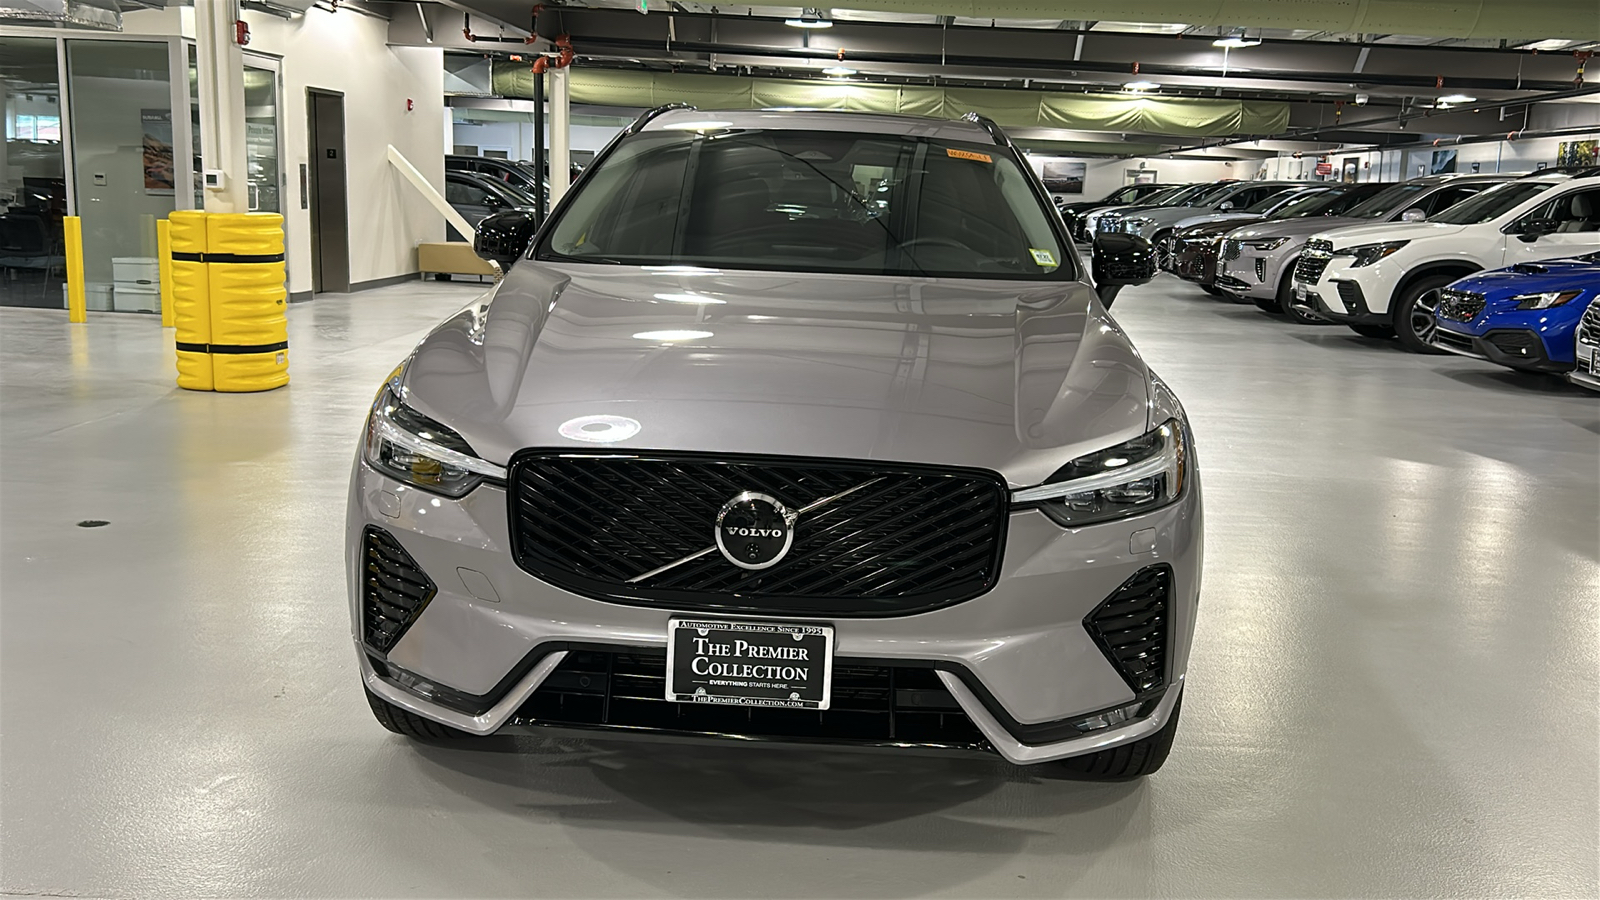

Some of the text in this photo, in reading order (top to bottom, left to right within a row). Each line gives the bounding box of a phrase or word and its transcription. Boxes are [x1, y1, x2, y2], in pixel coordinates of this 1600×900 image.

[726, 527, 782, 538] VOLVO
[680, 621, 822, 635] AUTOMOTIVE EXCELLENCE SINCE 1995
[692, 637, 810, 661] THE PREMIER
[691, 657, 809, 682] COLLECTION
[709, 679, 748, 687] EVERYTHING
[749, 681, 771, 689] STARTS
